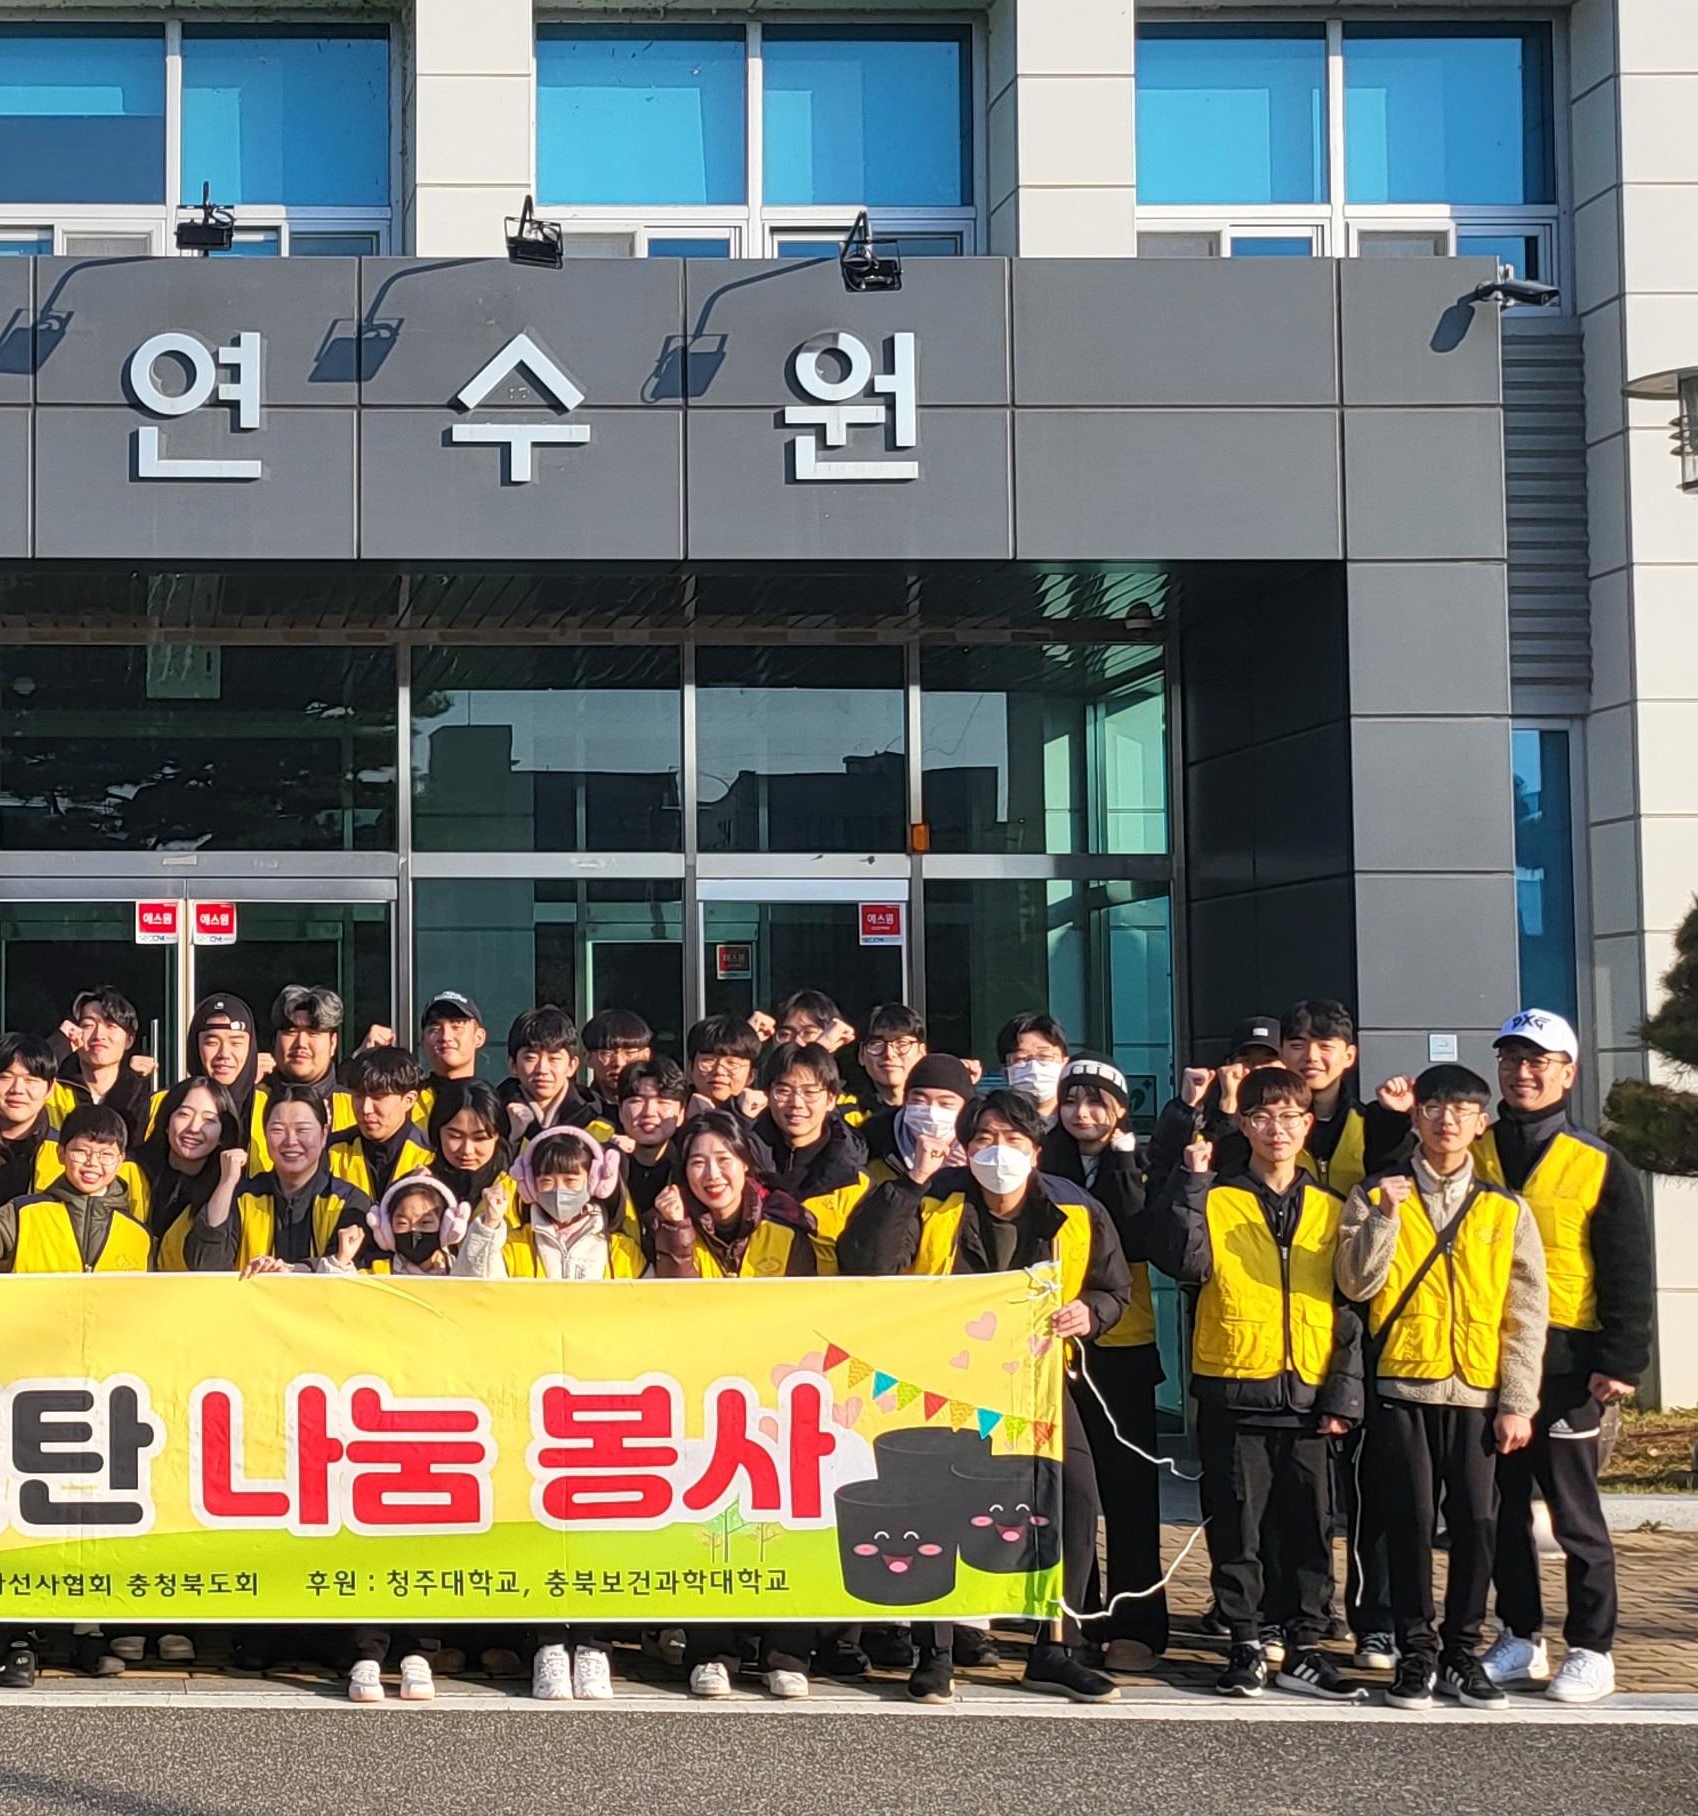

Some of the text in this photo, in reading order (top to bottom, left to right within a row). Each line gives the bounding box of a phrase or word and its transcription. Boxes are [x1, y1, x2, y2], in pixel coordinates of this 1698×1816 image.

[866, 913, 894, 925] 에스원
[201, 1385, 485, 1525] 나눔
[537, 1383, 837, 1519] 봉사
[126, 1571, 259, 1598] 충청북도회
[305, 1569, 357, 1597] 후원
[386, 1568, 531, 1599] 청주대학교,
[544, 1567, 791, 1597] 충북보건과학대학교
